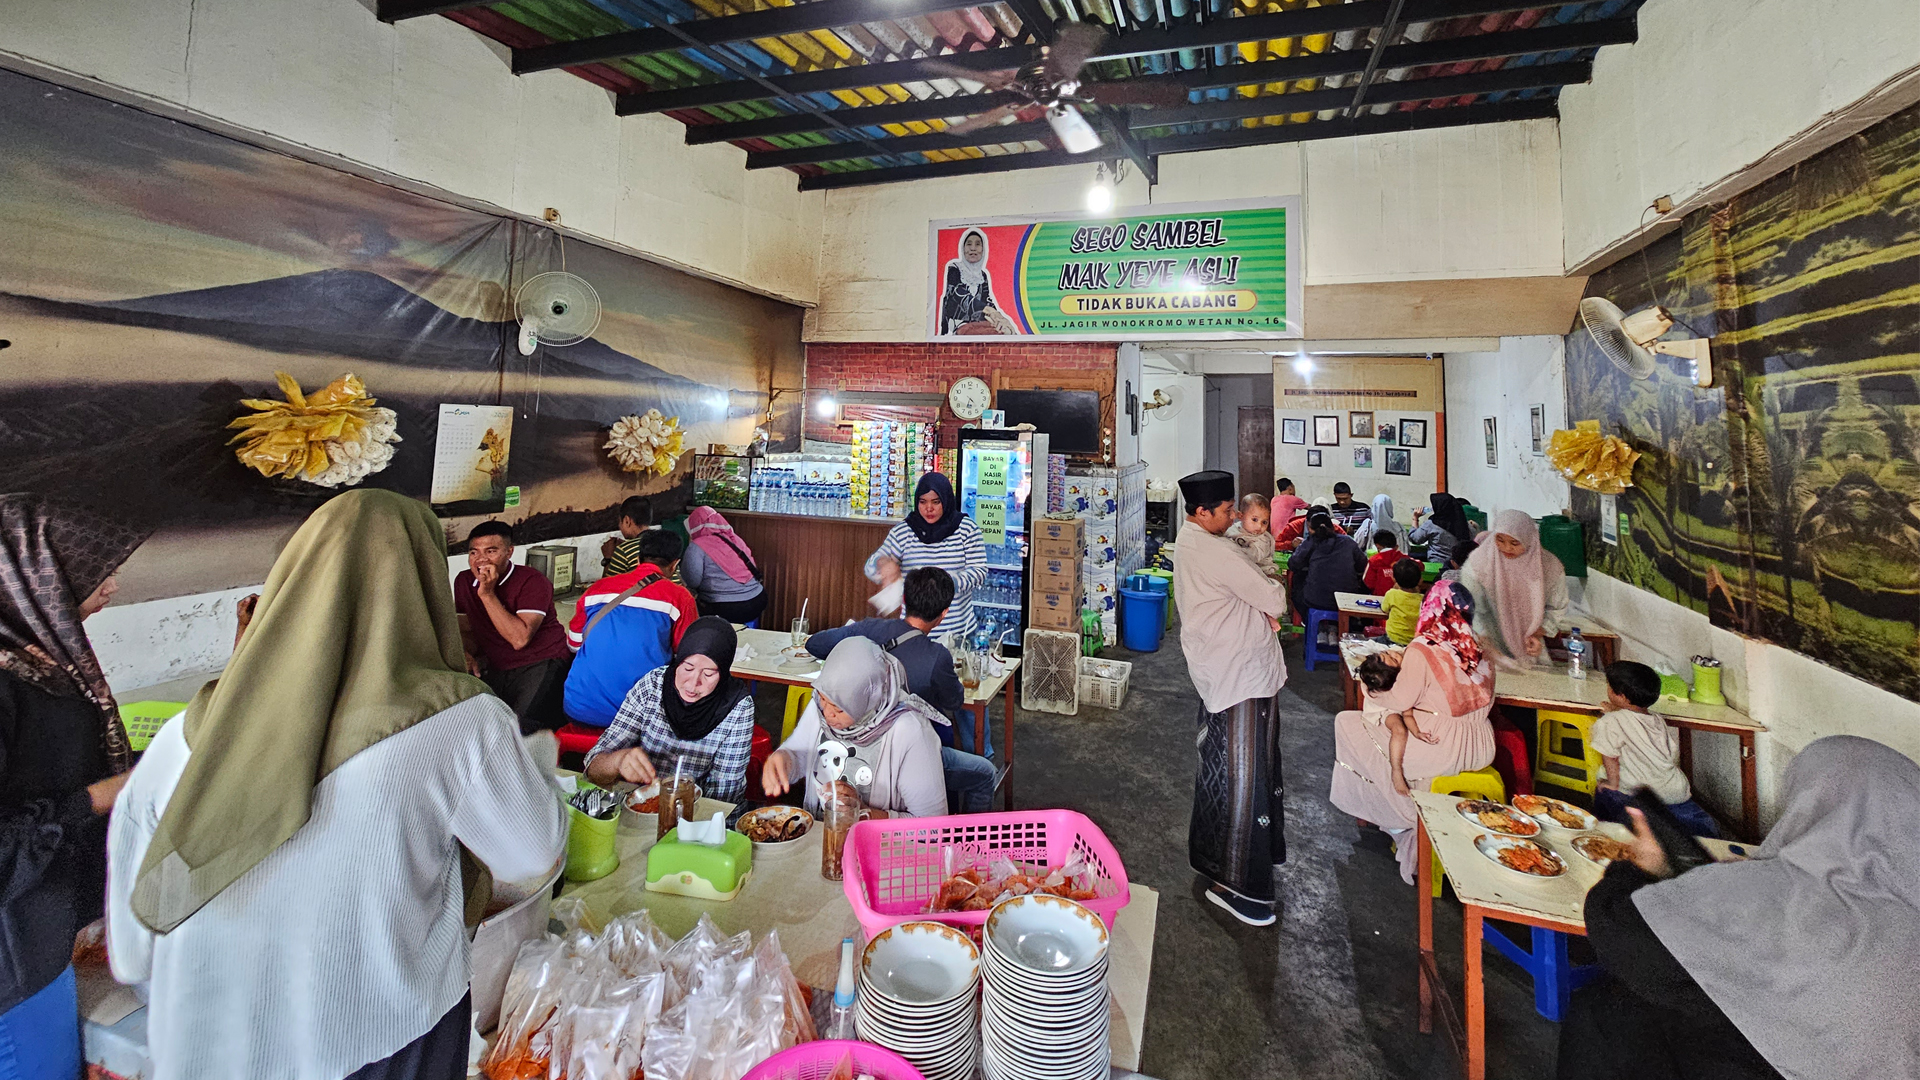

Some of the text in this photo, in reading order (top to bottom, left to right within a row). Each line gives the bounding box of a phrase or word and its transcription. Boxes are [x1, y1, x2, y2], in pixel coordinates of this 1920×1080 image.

[1070, 217, 1227, 254] SEGO SAMBEL
[1058, 255, 1240, 290] MAK YEYE ASLI
[1076, 294, 1237, 311] TIDAK BUKA CABANG
[1062, 320, 1098, 328] JAGIR
[1102, 318, 1183, 328] WONOKROMO
[1187, 318, 1233, 326] WETAN
[1237, 317, 1259, 325] No.
[1265, 317, 1279, 325] 16
